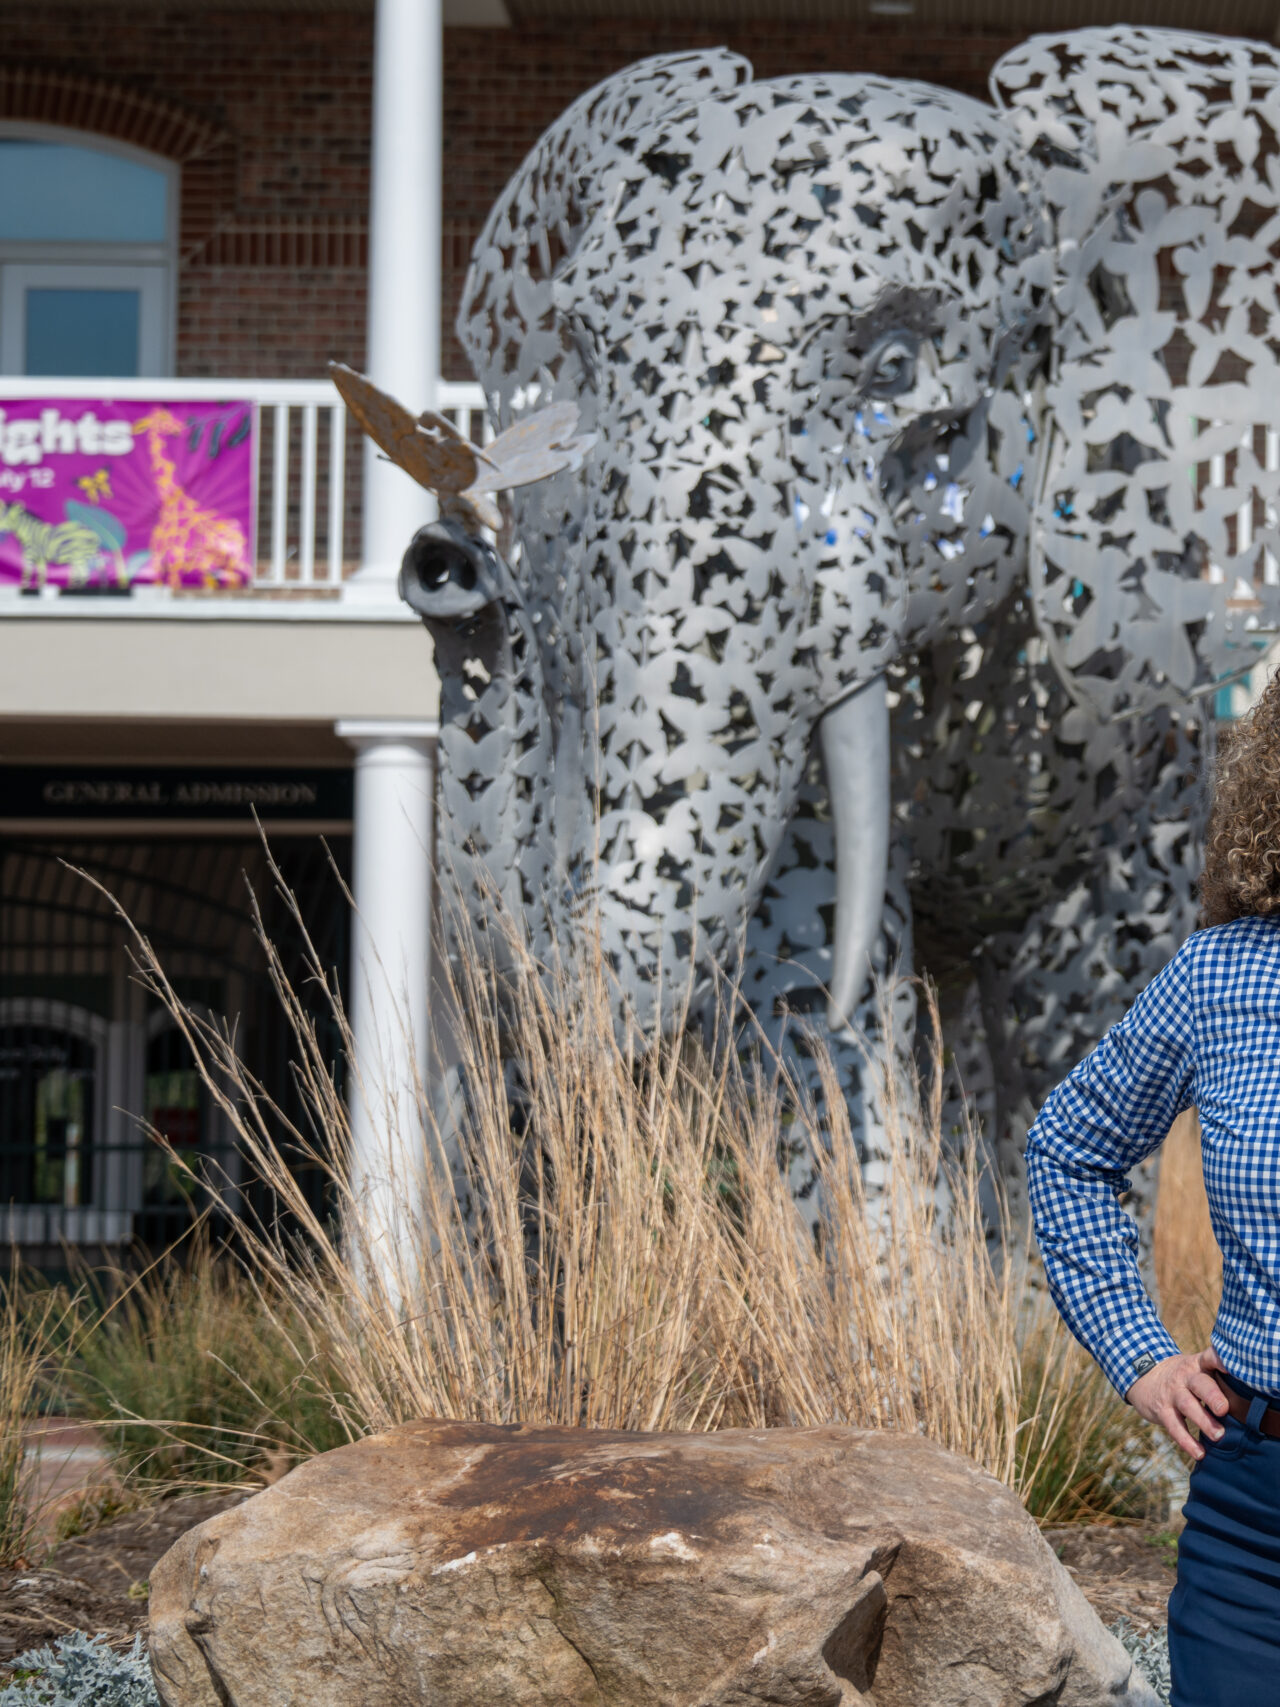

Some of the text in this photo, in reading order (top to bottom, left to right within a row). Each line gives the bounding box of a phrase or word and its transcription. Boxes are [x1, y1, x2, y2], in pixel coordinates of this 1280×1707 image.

[0, 407, 135, 466] ghts
[42, 782, 318, 804] GENERAL ADMISSION
